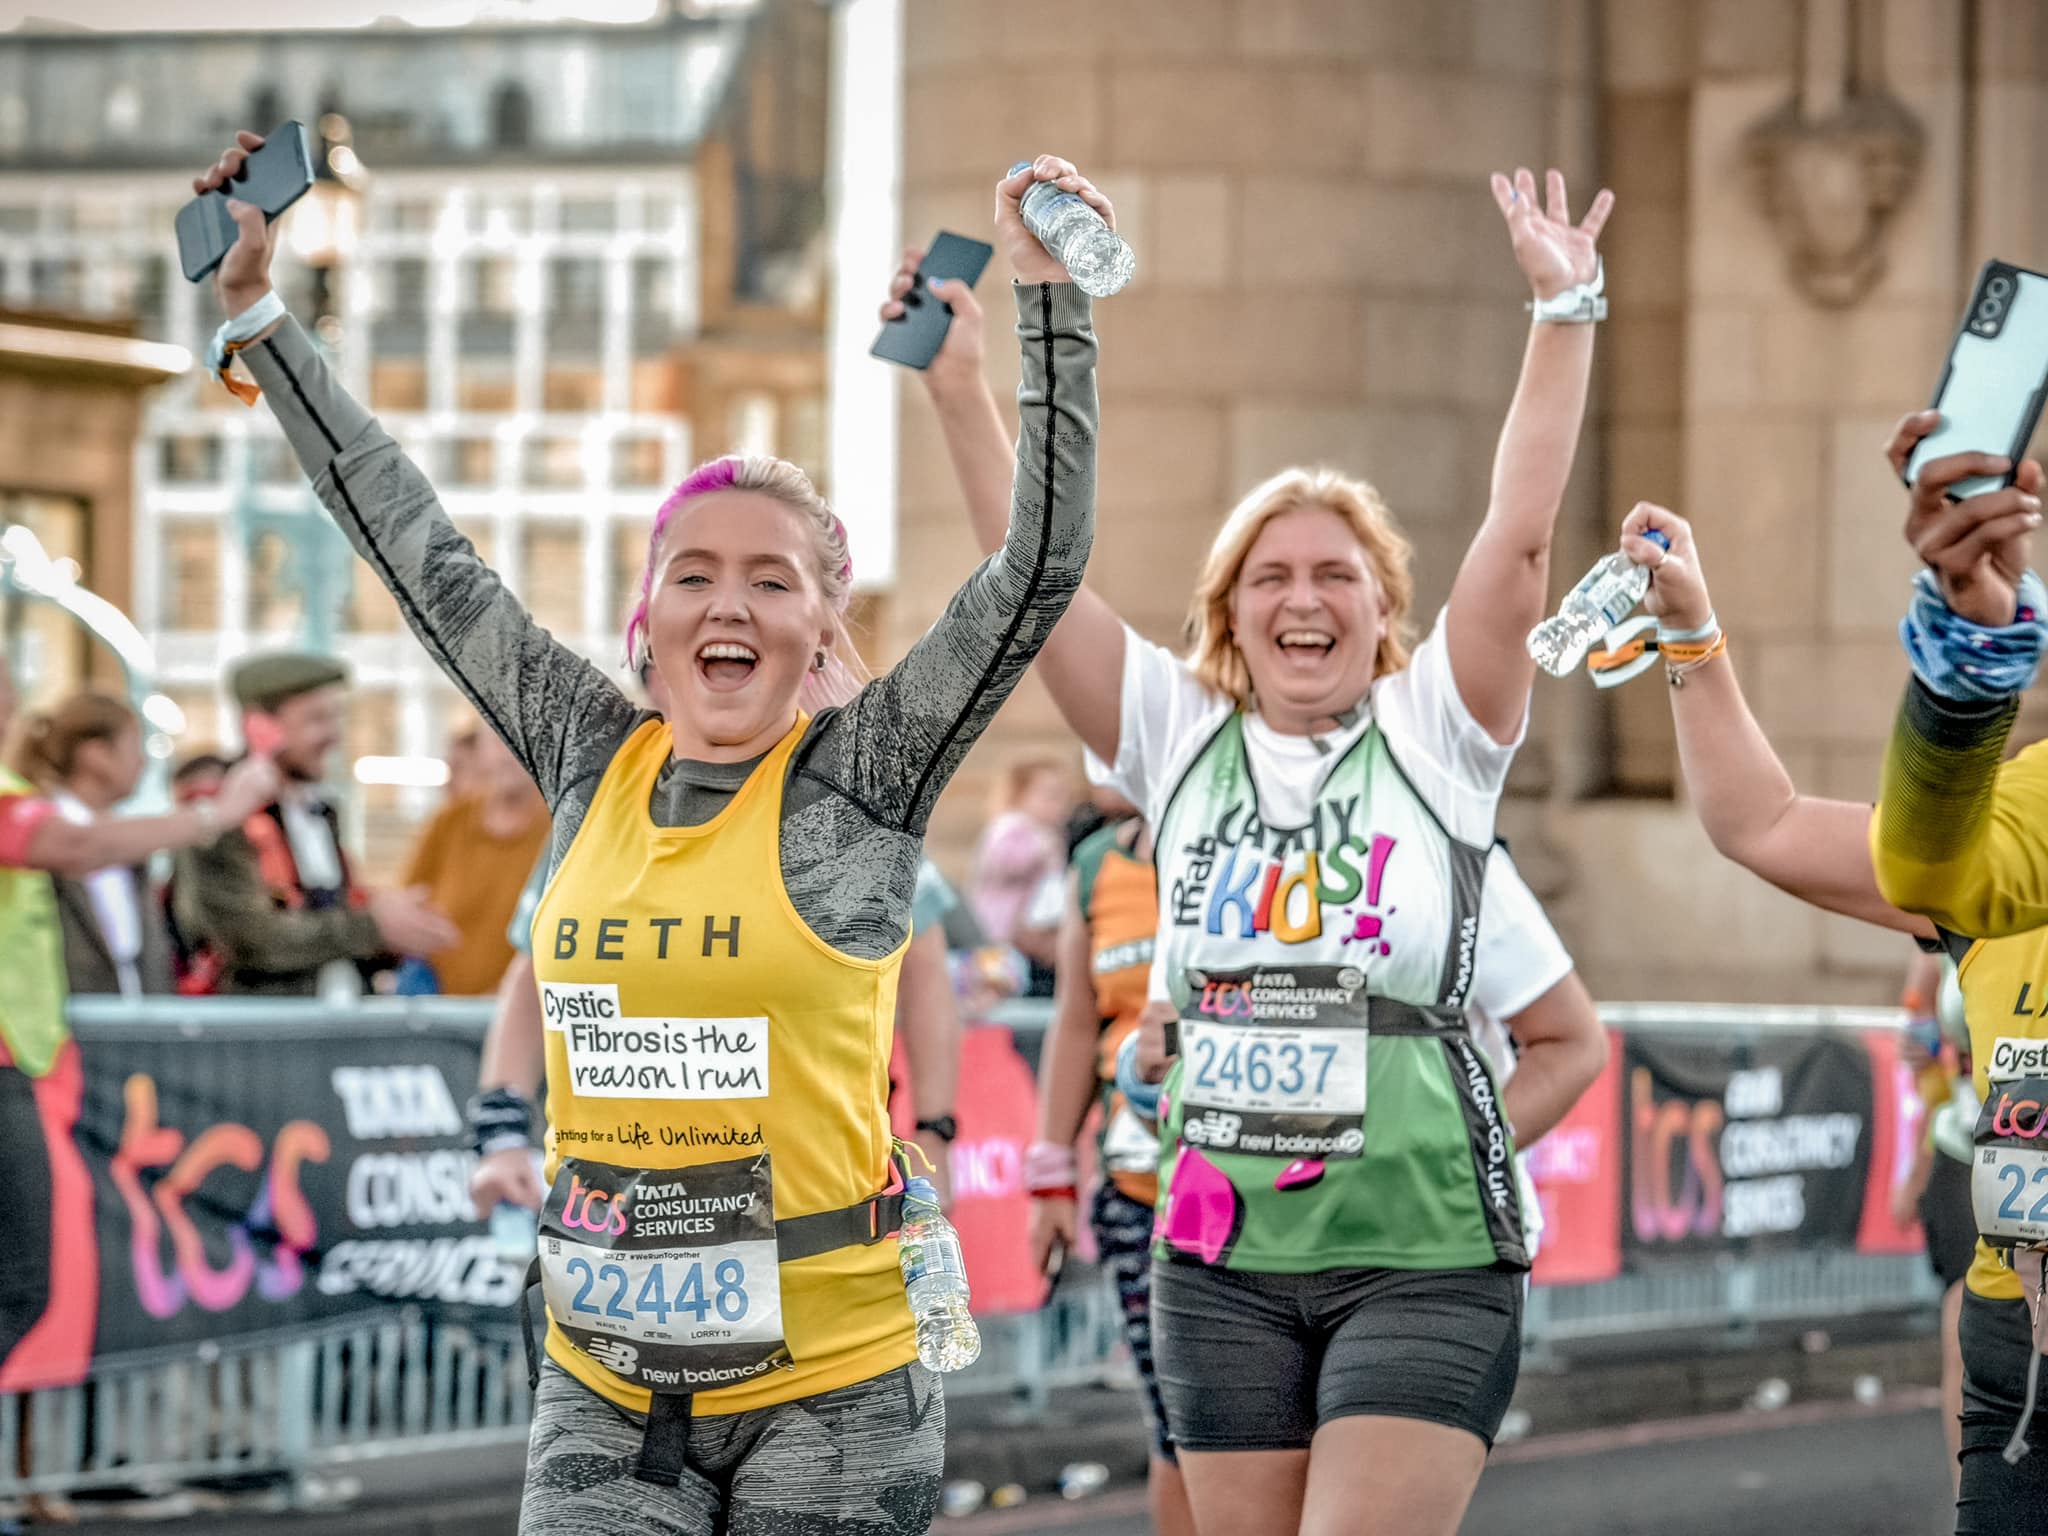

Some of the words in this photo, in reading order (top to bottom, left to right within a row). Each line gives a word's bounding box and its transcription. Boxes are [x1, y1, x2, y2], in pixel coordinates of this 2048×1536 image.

[554, 915, 740, 960] BETH
[1252, 972, 1297, 988] TATA
[544, 988, 614, 1024] Cystic
[1250, 988, 1353, 1004] CONSULTANCY
[1252, 1004, 1317, 1019] SERVICES
[691, 1025, 756, 1054] the
[575, 1065, 675, 1089] reason
[681, 1062, 690, 1090] I
[697, 1065, 763, 1090] run
[1195, 1036, 1339, 1095] 24637
[590, 1130, 605, 1142] for
[607, 1133, 614, 1142] a
[617, 1122, 653, 1150] Life
[660, 1123, 764, 1147] Unlimited
[1240, 1134, 1274, 1150] new
[109, 1072, 332, 1319] tcs
[634, 1182, 687, 1200] TATA
[561, 1175, 628, 1236] tcs
[633, 1192, 757, 1219] CONSULTANCY
[632, 1218, 716, 1238] SERVICES
[565, 1256, 749, 1325] 22448
[690, 1331, 719, 1339] LORRY
[641, 1367, 680, 1385] new
[684, 1360, 770, 1383] balance
